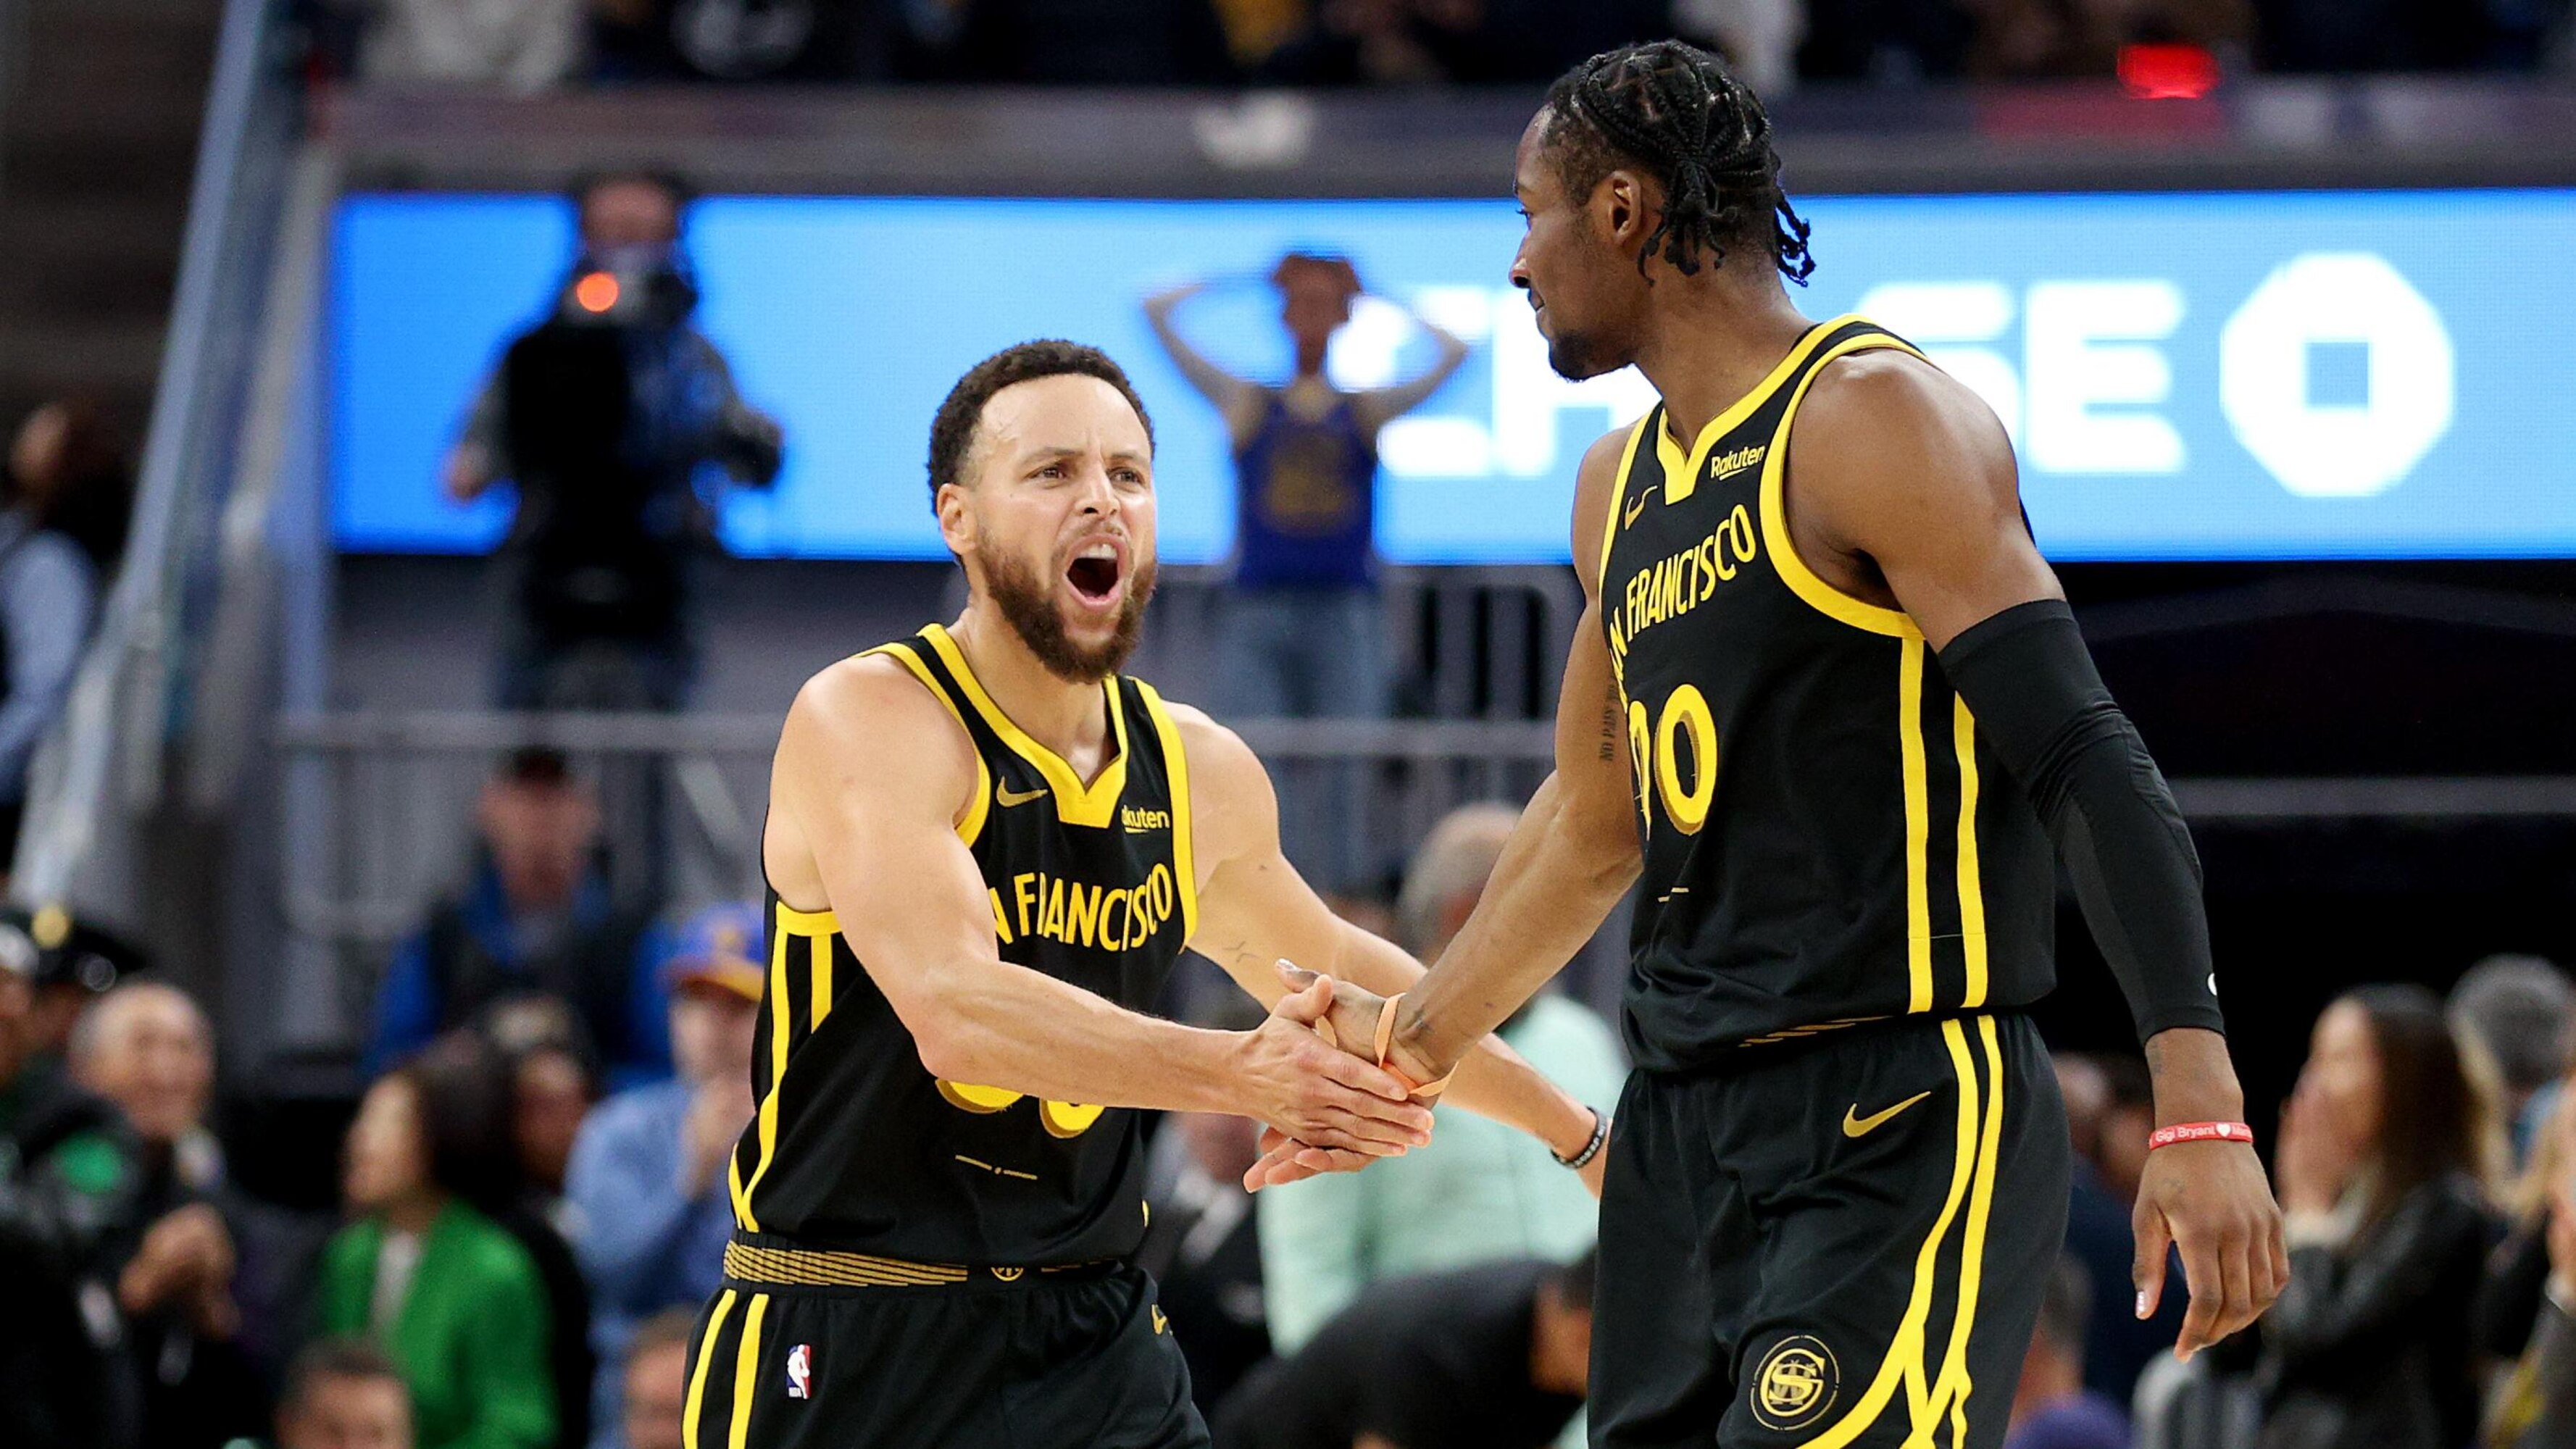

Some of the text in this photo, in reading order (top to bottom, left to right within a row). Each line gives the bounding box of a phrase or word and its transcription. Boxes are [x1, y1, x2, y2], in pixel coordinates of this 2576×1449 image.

[1711, 445, 1765, 478] Rakuten
[1626, 504, 1756, 642] FRANCISCO
[1122, 804, 1170, 829] kuten
[2155, 1125, 2216, 1143] Gigi Bryant
